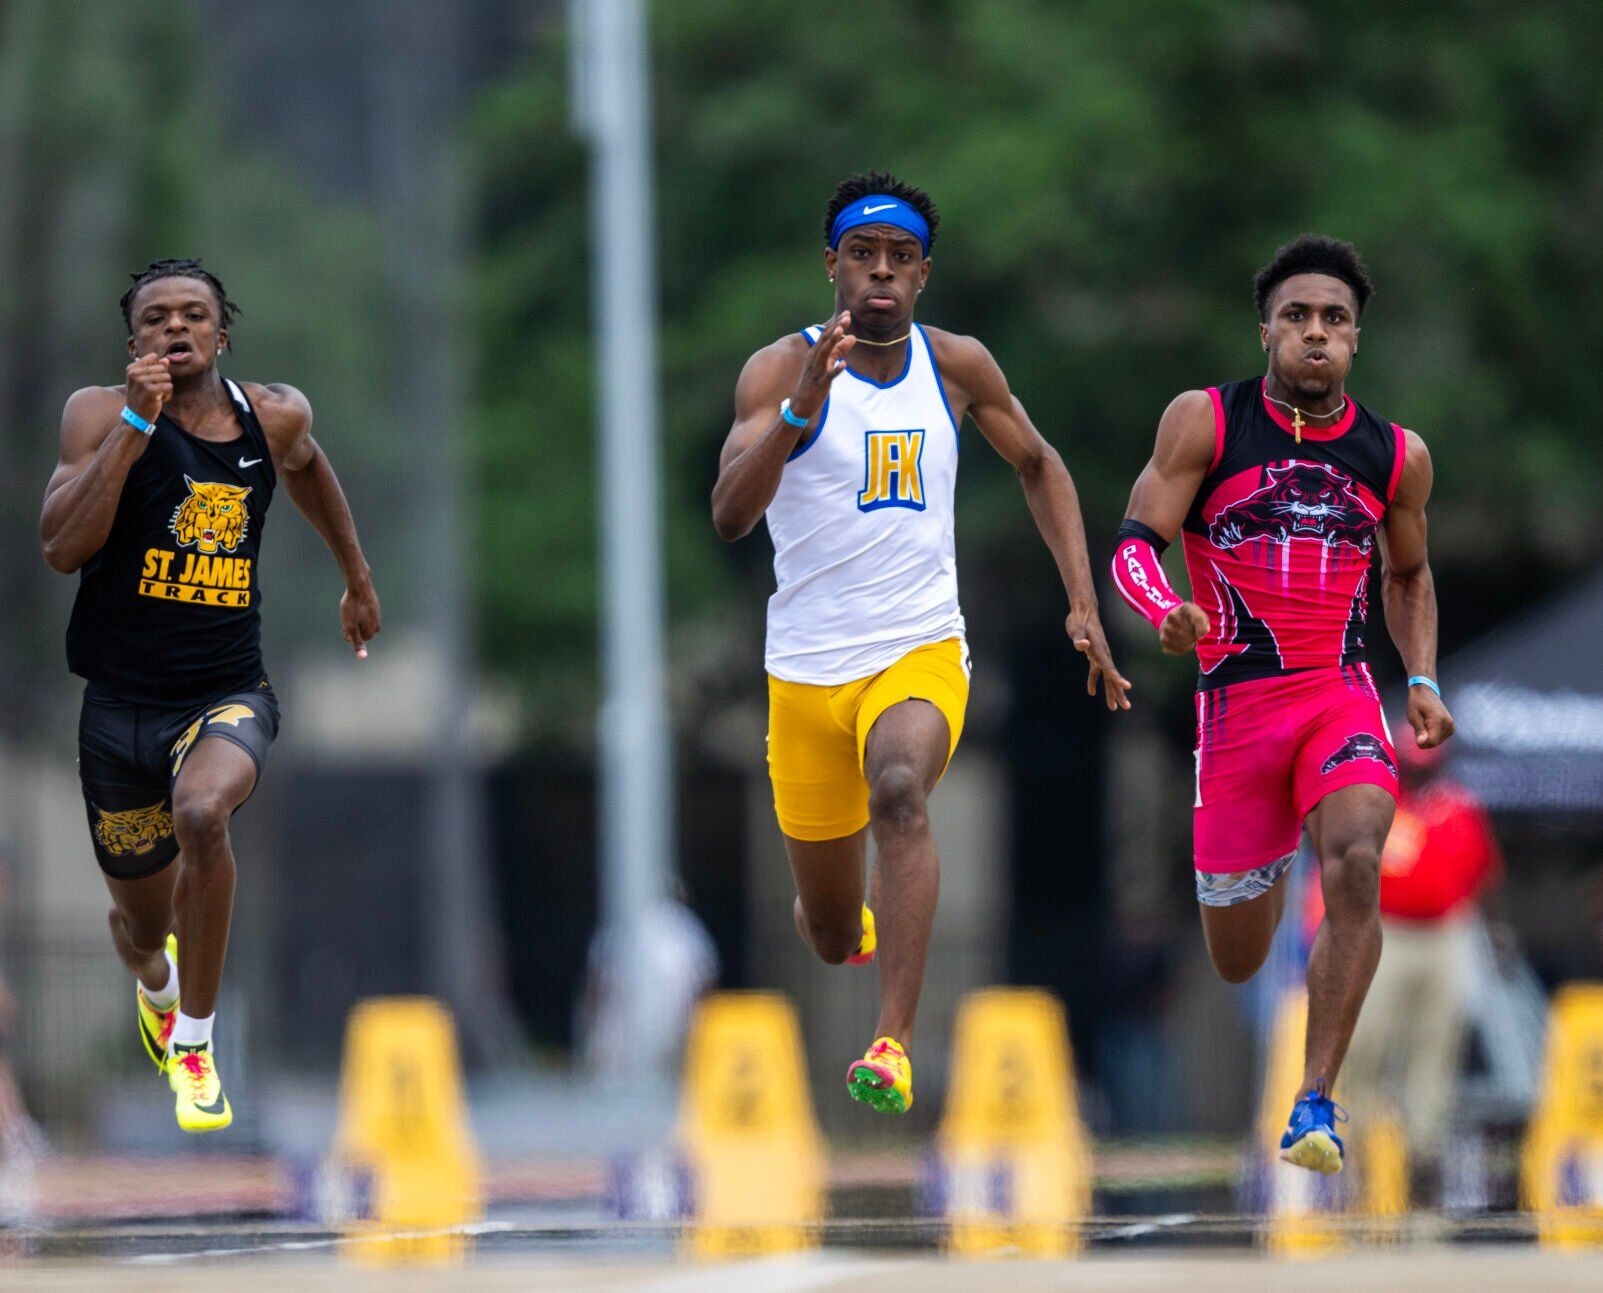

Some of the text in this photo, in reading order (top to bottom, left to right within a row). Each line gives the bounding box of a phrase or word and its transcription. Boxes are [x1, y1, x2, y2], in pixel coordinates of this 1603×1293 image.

[858, 431, 924, 509] JFK
[142, 548, 252, 589] ST. JAMES
[142, 581, 248, 605] TRACK
